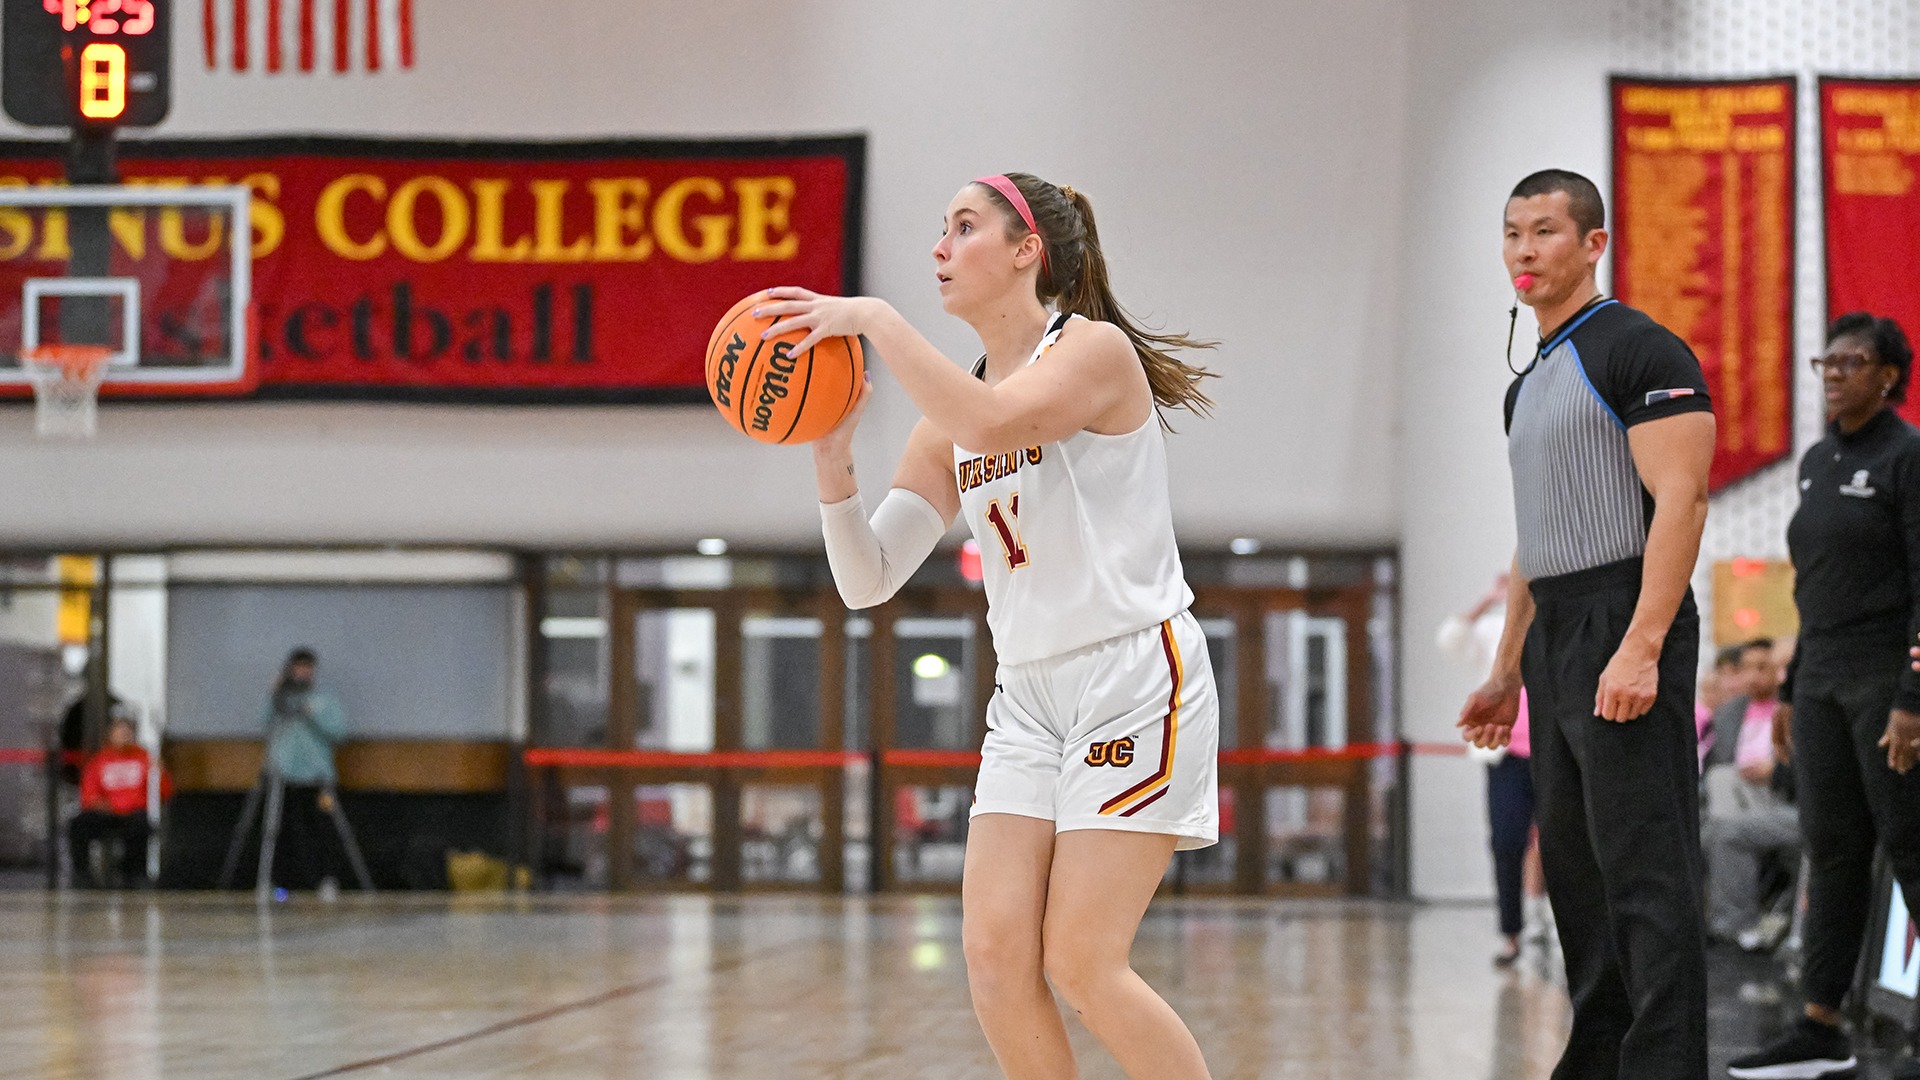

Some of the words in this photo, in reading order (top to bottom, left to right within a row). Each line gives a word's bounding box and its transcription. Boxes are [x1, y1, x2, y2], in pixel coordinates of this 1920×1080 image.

[315, 173, 800, 263] COLLEGE
[716, 332, 747, 408] NCAA
[751, 340, 799, 432] Wilson
[959, 445, 1043, 494] URSINS
